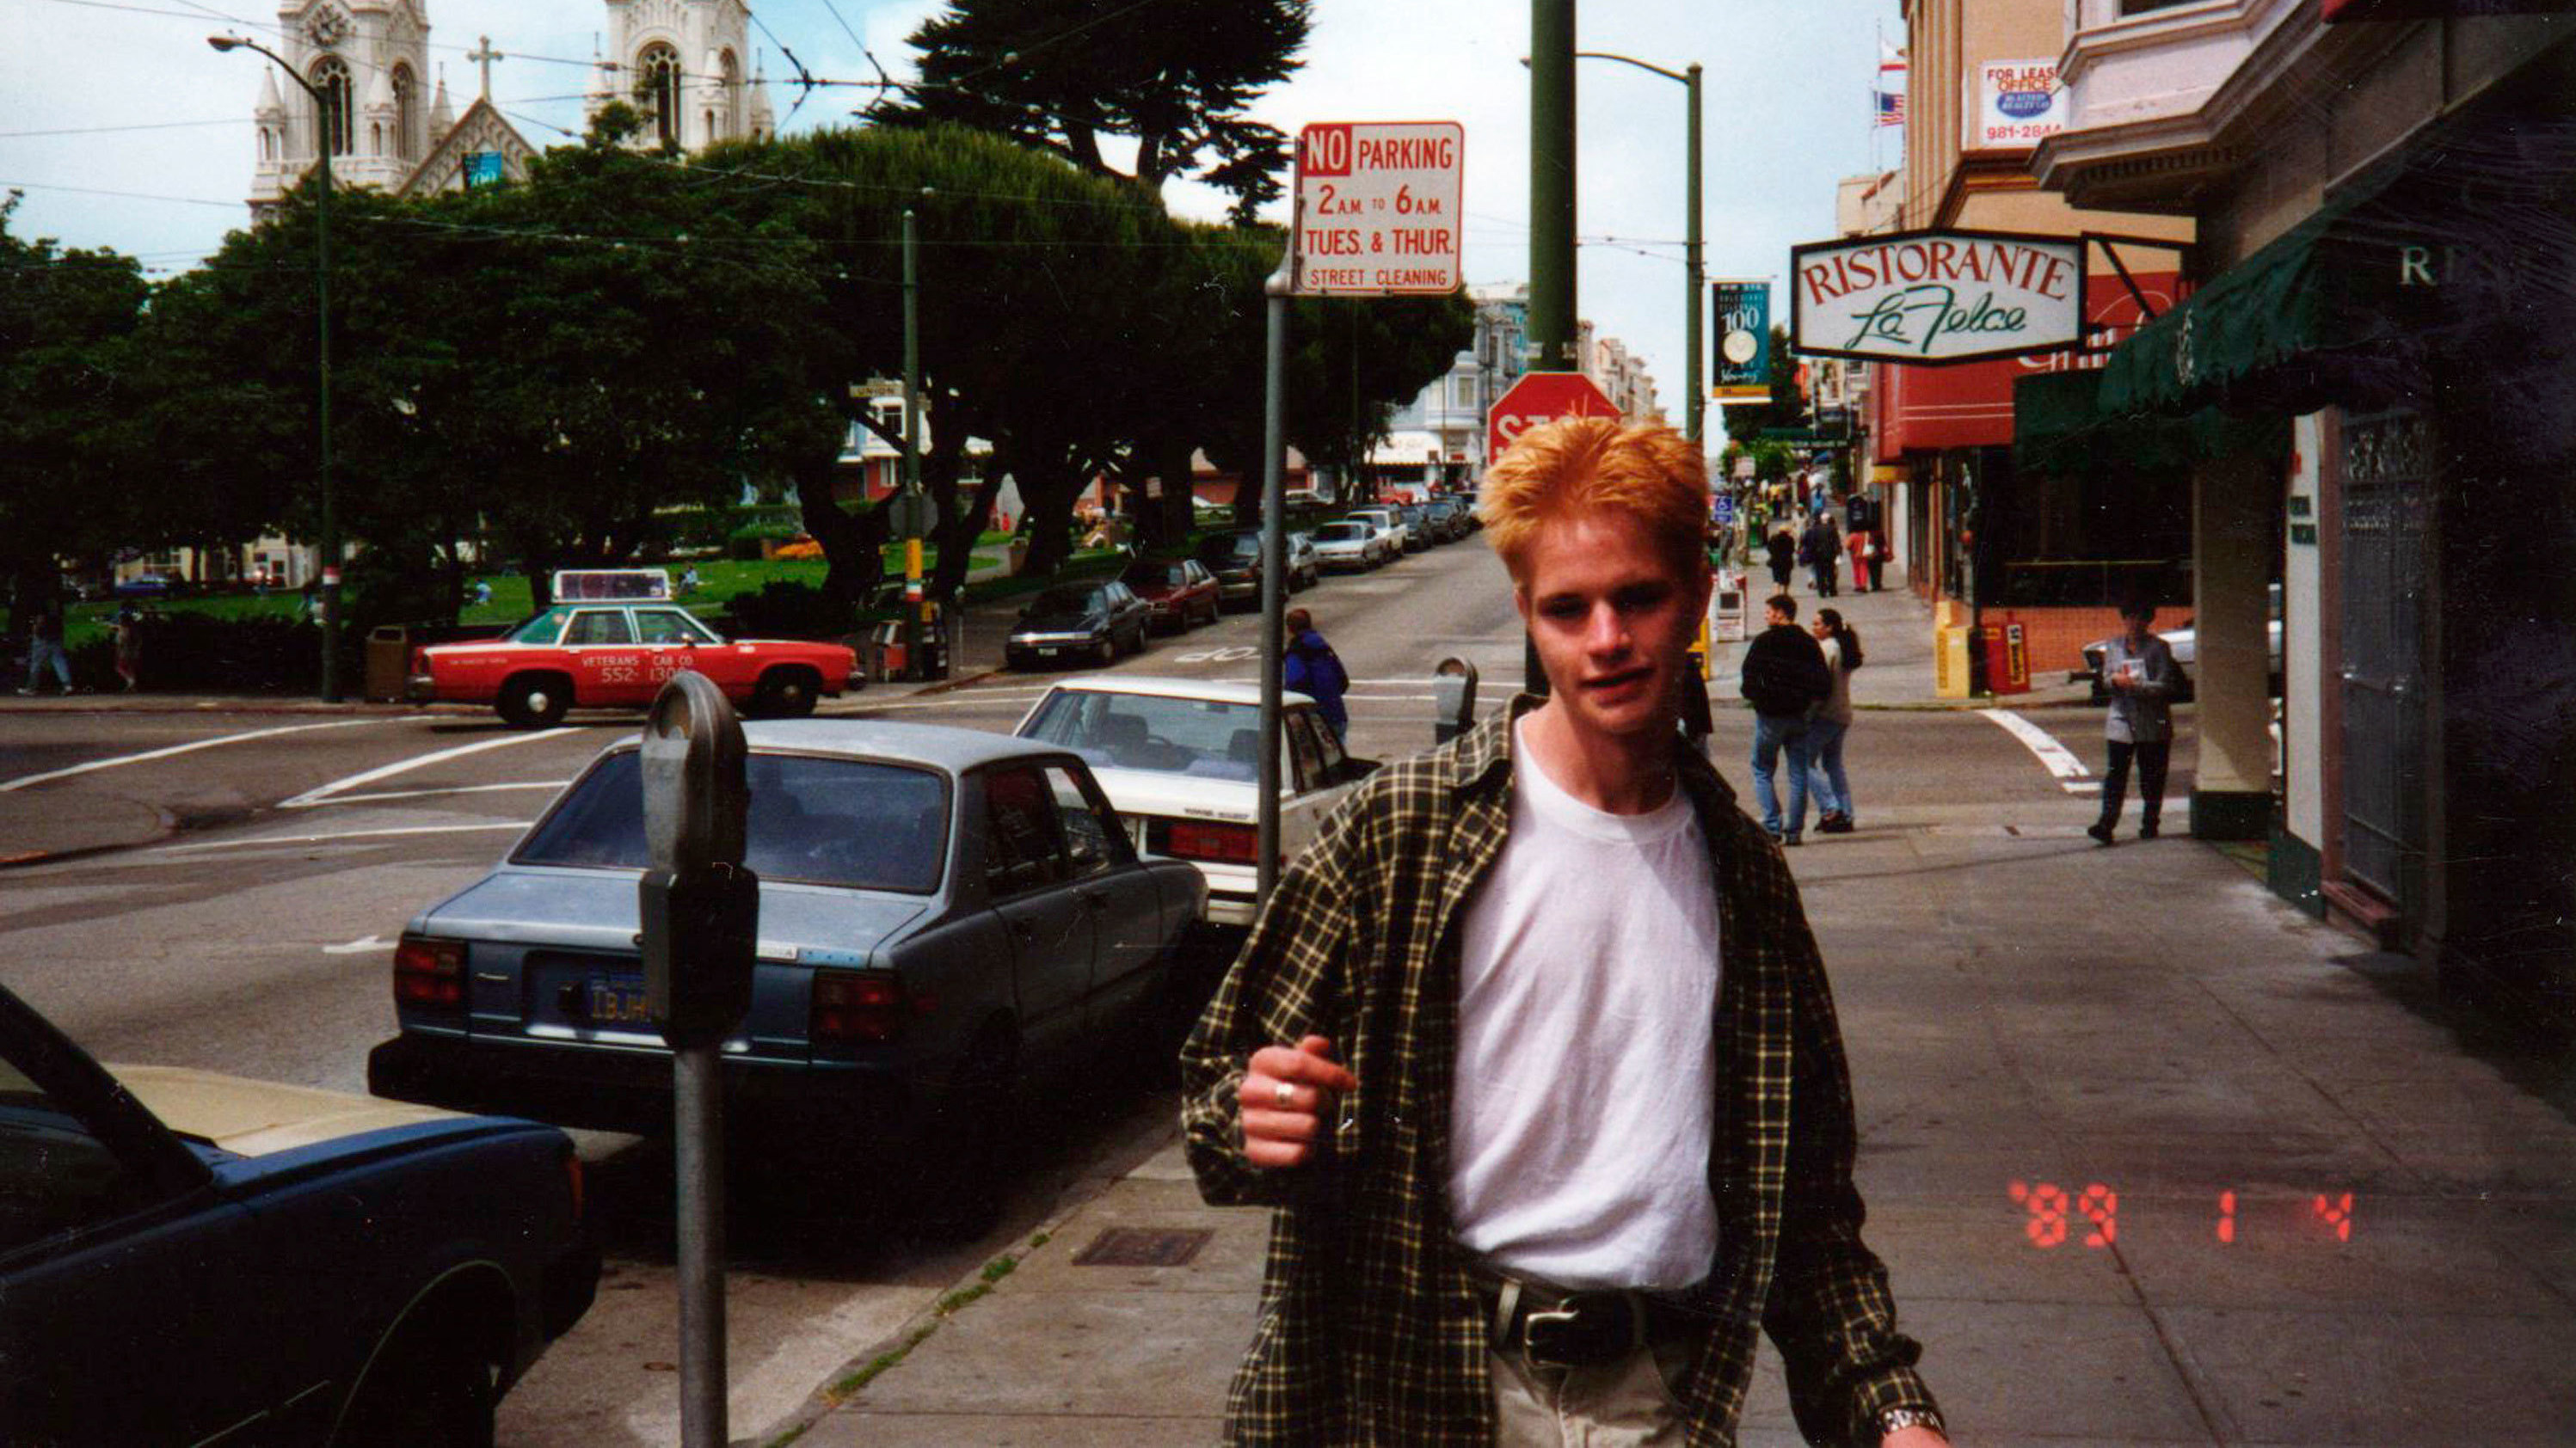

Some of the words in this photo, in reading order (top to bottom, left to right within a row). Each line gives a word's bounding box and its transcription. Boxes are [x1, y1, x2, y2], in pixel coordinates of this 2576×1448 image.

[1988, 69, 2013, 81] FOR
[2021, 67, 2061, 79] LEAS
[1998, 79, 2051, 91] OFFICE
[1307, 129, 1347, 171] NO
[1359, 138, 1453, 169] PARKING
[1372, 199, 1385, 211] TO
[1306, 229, 1363, 255] TUES.
[1371, 232, 1384, 253] &
[1393, 229, 1454, 255] THUR.
[1310, 269, 1365, 285] STREET
[1376, 269, 1447, 285] CLEANING
[1803, 242, 2075, 306] RISTORANTE
[1721, 307, 1760, 332] 100
[1844, 292, 1912, 351] La
[582, 655, 639, 667] VETERANS
[653, 655, 673, 666] CAB
